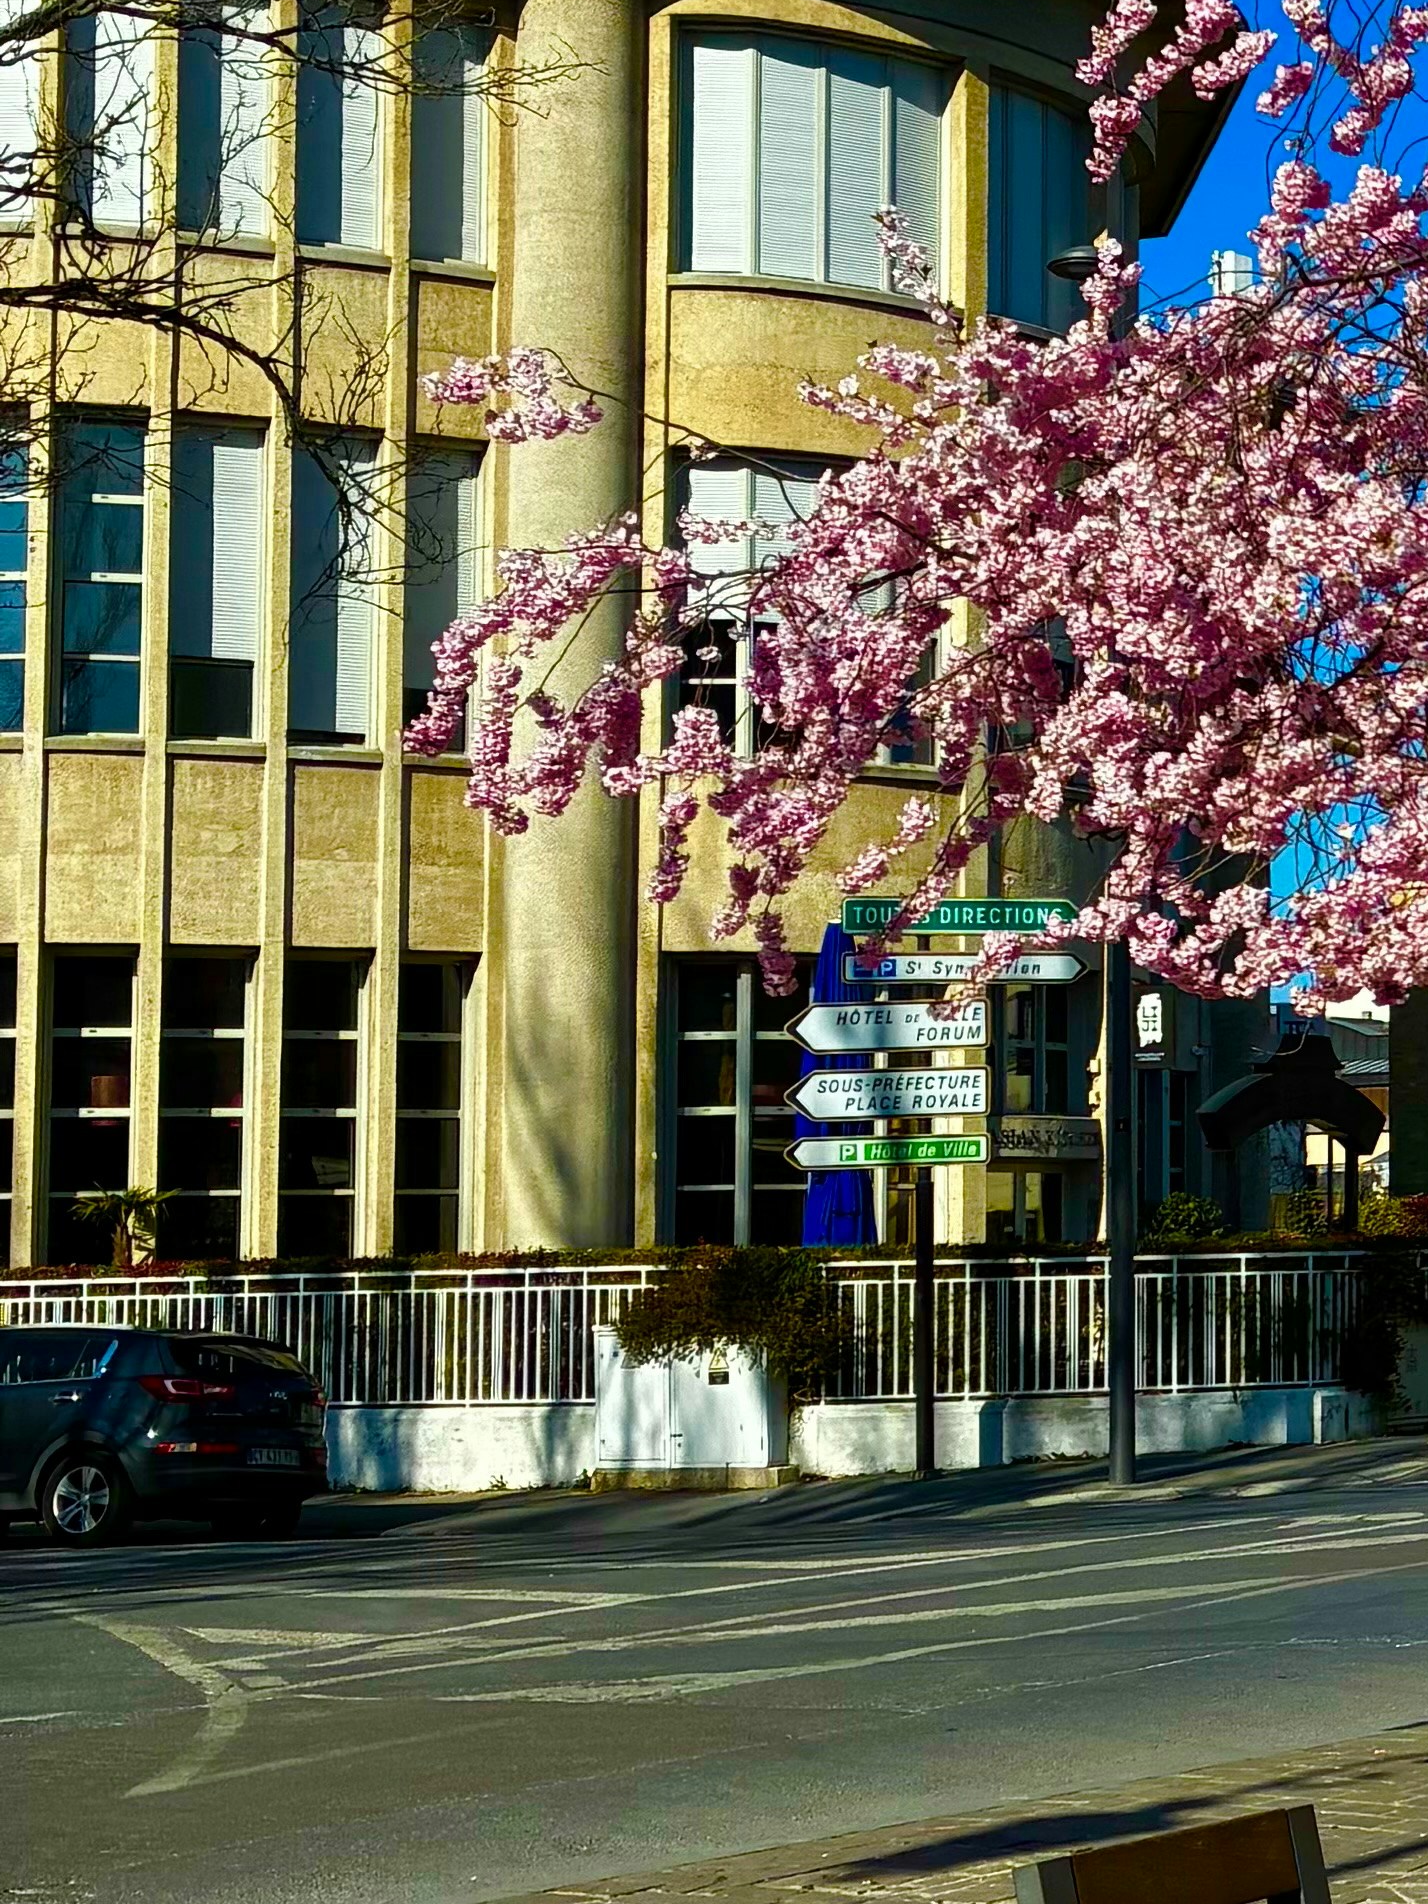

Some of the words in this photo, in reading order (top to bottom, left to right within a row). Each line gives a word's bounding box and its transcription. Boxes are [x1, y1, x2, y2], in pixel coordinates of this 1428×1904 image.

[836, 1008, 893, 1026] HÔTEL
[905, 1014, 920, 1024] DE
[916, 1026, 982, 1042] FORUM
[817, 1074, 982, 1094] SOUS-PRÉFECTURE
[845, 1096, 901, 1111] PLACE
[912, 1094, 982, 1109] ROYALE
[870, 1142, 912, 1159] Hôtel
[918, 1142, 936, 1158] de
[944, 1141, 977, 1157] Ville
